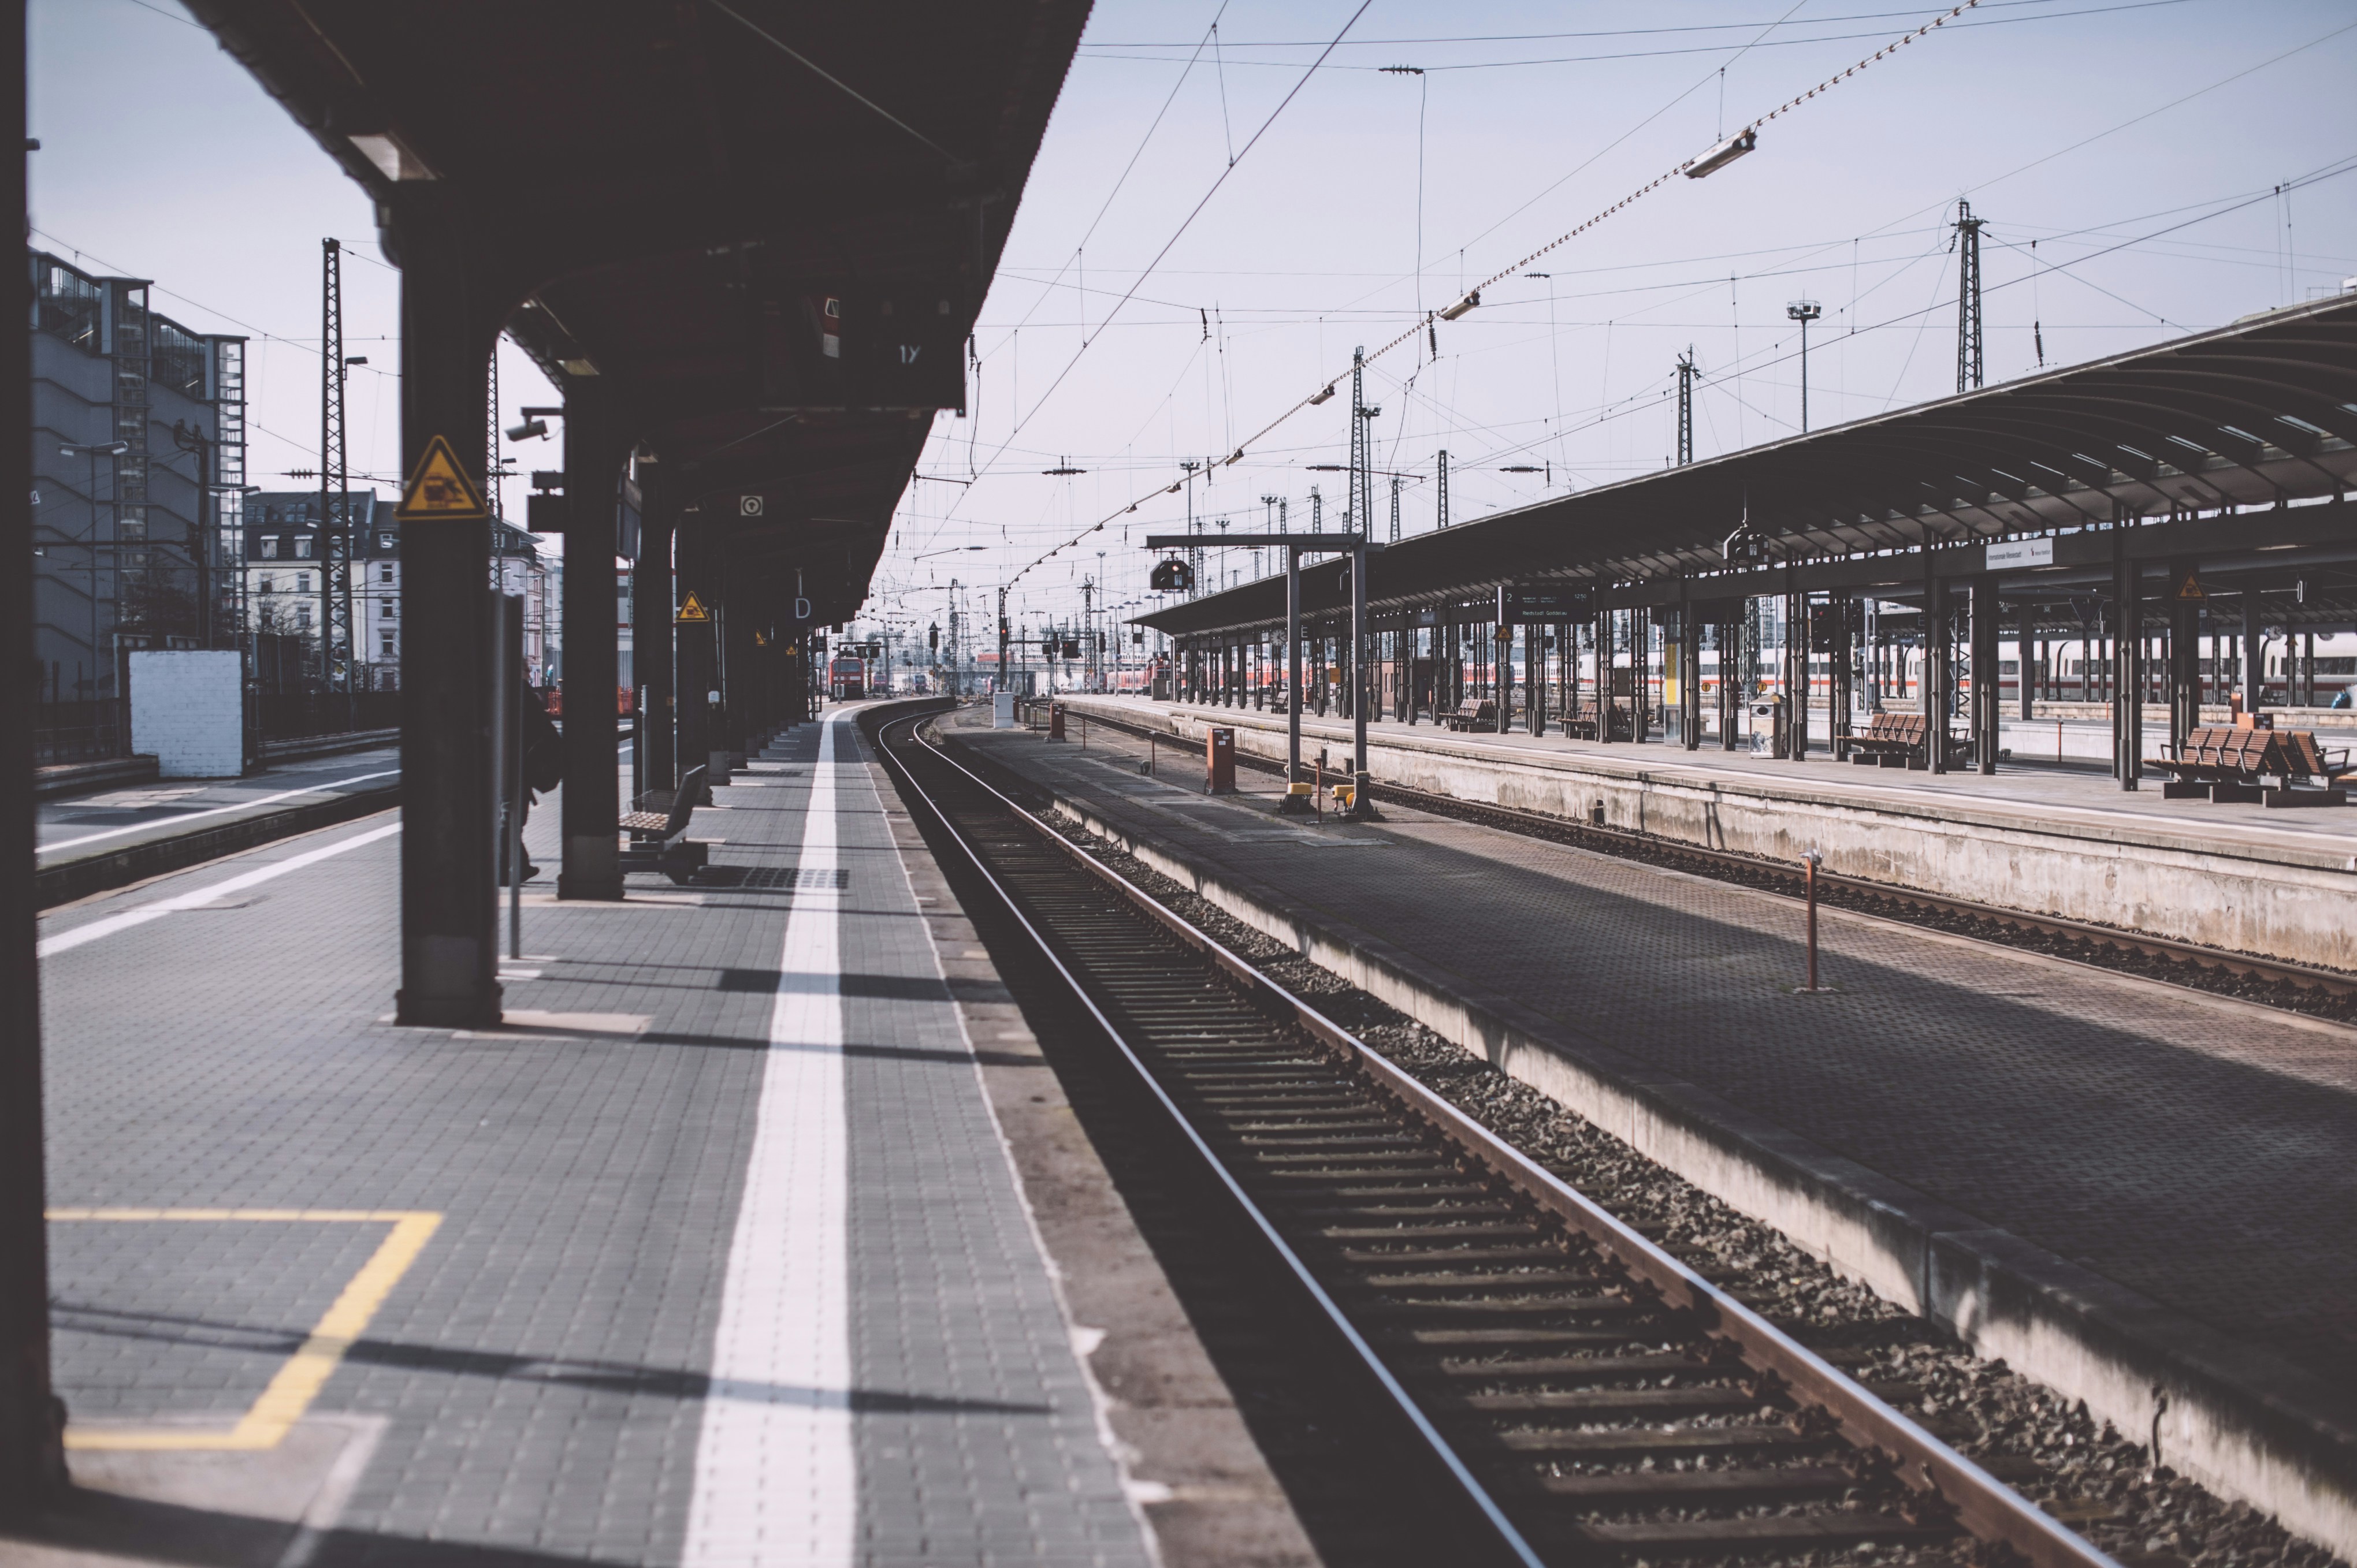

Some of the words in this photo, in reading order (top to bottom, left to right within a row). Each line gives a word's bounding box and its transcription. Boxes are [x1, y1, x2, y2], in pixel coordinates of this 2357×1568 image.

[1507, 593, 1512, 602] 2
[795, 598, 811, 619] D
[1301, 627, 1308, 638] E
[817, 637, 825, 648] E
[1176, 643, 1181, 651] F
